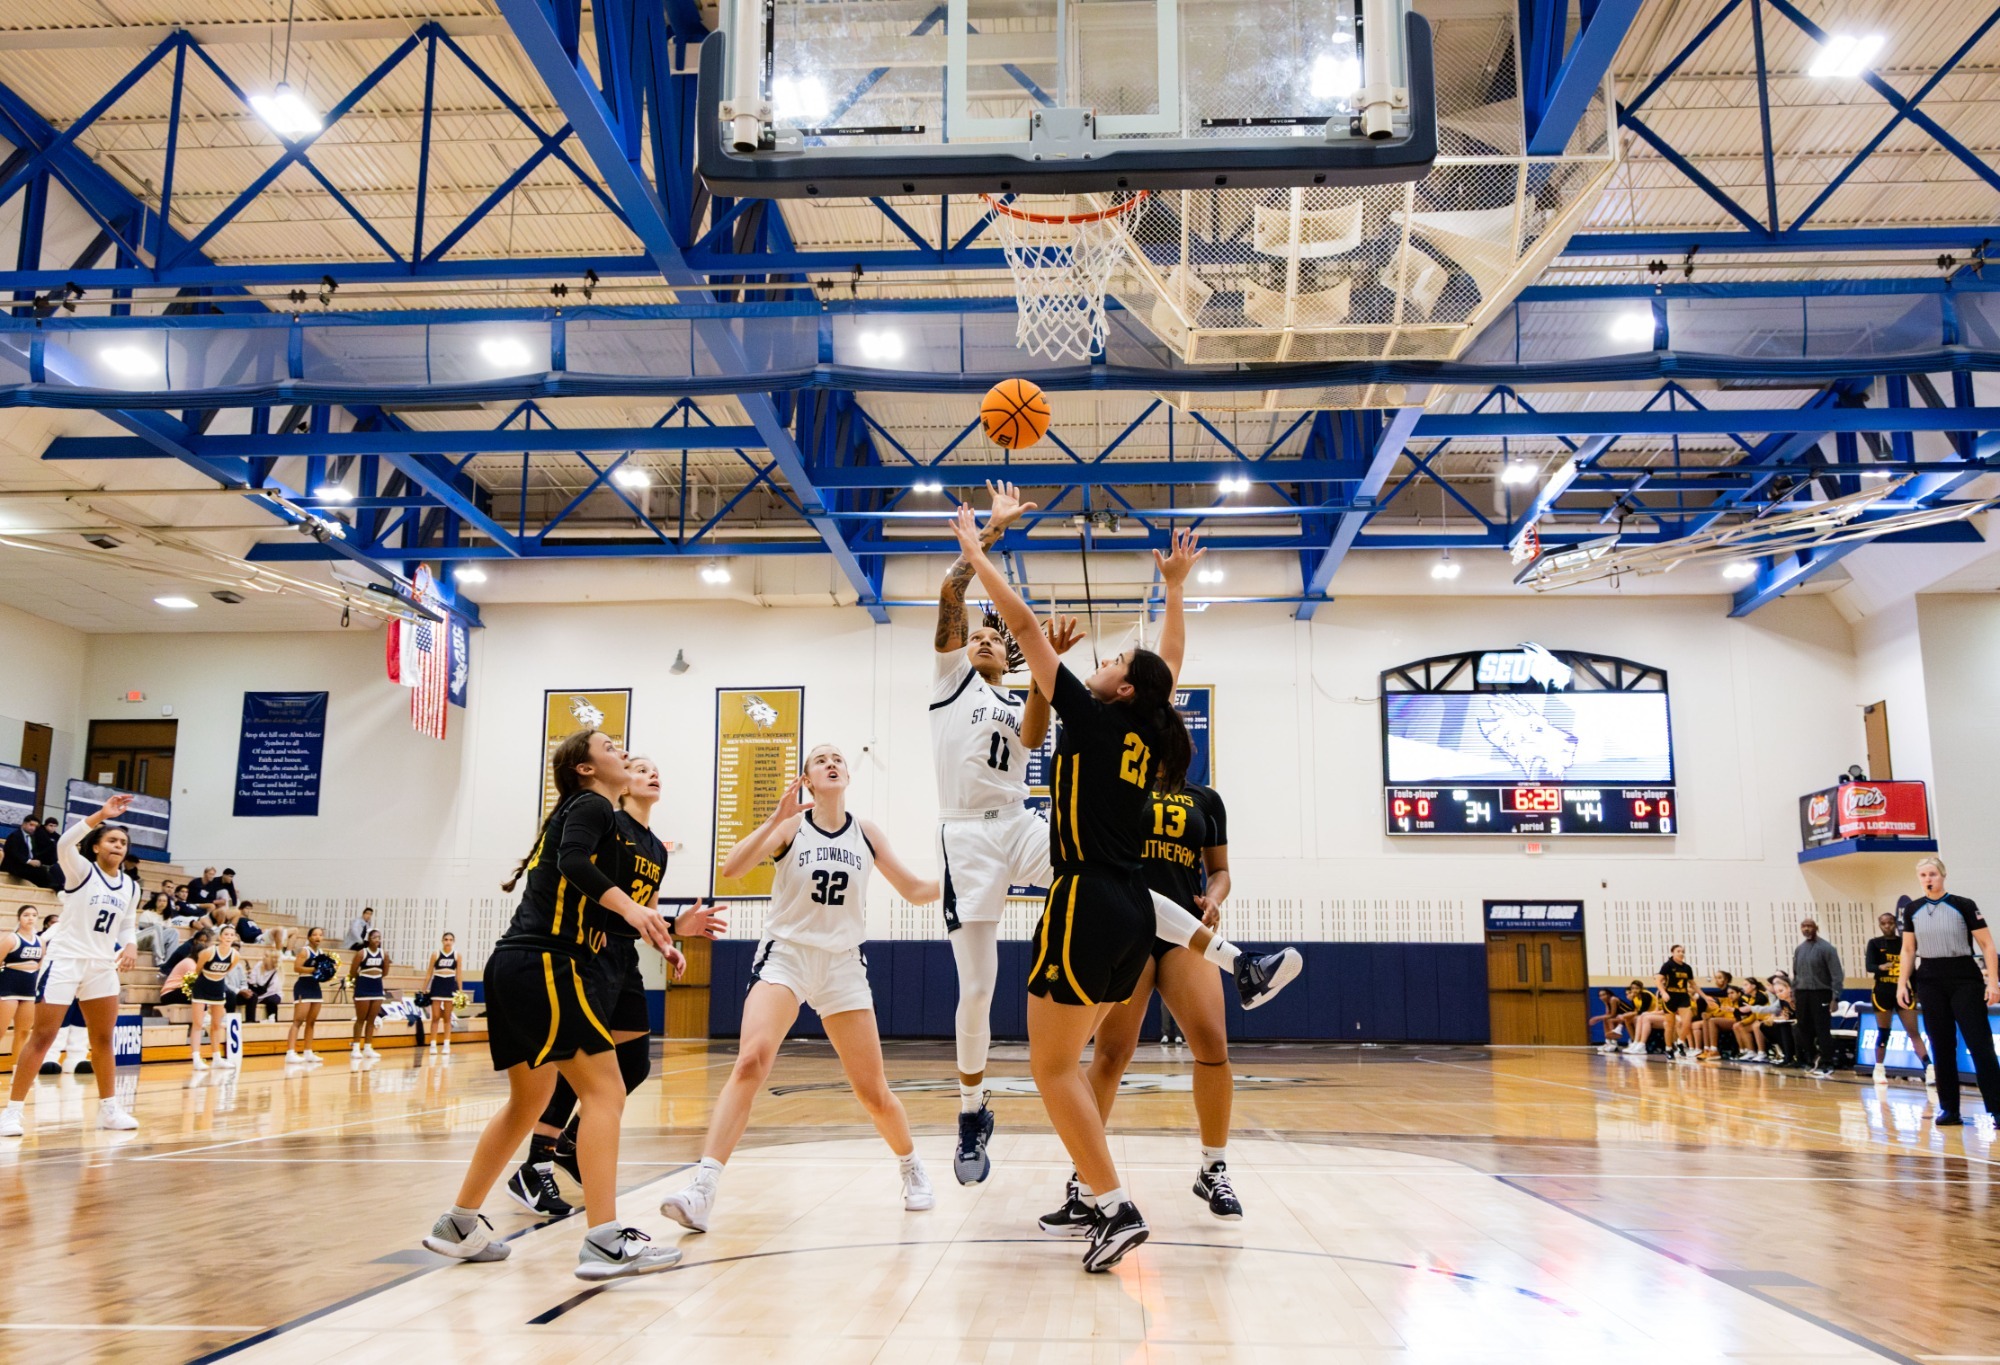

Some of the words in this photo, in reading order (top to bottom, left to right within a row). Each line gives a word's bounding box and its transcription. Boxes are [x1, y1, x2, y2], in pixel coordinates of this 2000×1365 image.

[1477, 652, 1532, 684] SEU
[1174, 693, 1190, 706] EU
[972, 707, 987, 724] ST.
[987, 731, 1010, 772] 11
[1120, 732, 1151, 790] 21
[1152, 791, 1194, 807] EXAS
[1515, 789, 1558, 810] 6:29
[984, 809, 999, 819] SEU
[1153, 803, 1186, 838] 13
[1418, 800, 1428, 816] 0
[1466, 801, 1491, 823] 34
[1576, 802, 1602, 822] 44
[1658, 800, 1670, 816] 0
[1398, 817, 1409, 832] 4
[1416, 820, 1434, 829] team
[1520, 822, 1544, 832] period
[1550, 817, 1560, 834] 3
[1630, 821, 1649, 829] team
[1660, 817, 1670, 833] 0
[1866, 821, 1916, 831] LOCATIONS
[799, 850, 812, 867] ST.
[1141, 840, 1195, 868] UTHERAN
[811, 870, 849, 905] 32
[93, 909, 116, 934] 21
[20, 946, 42, 959] SEU
[113, 1025, 141, 1056] OPPERS
[230, 1019, 239, 1054] S
